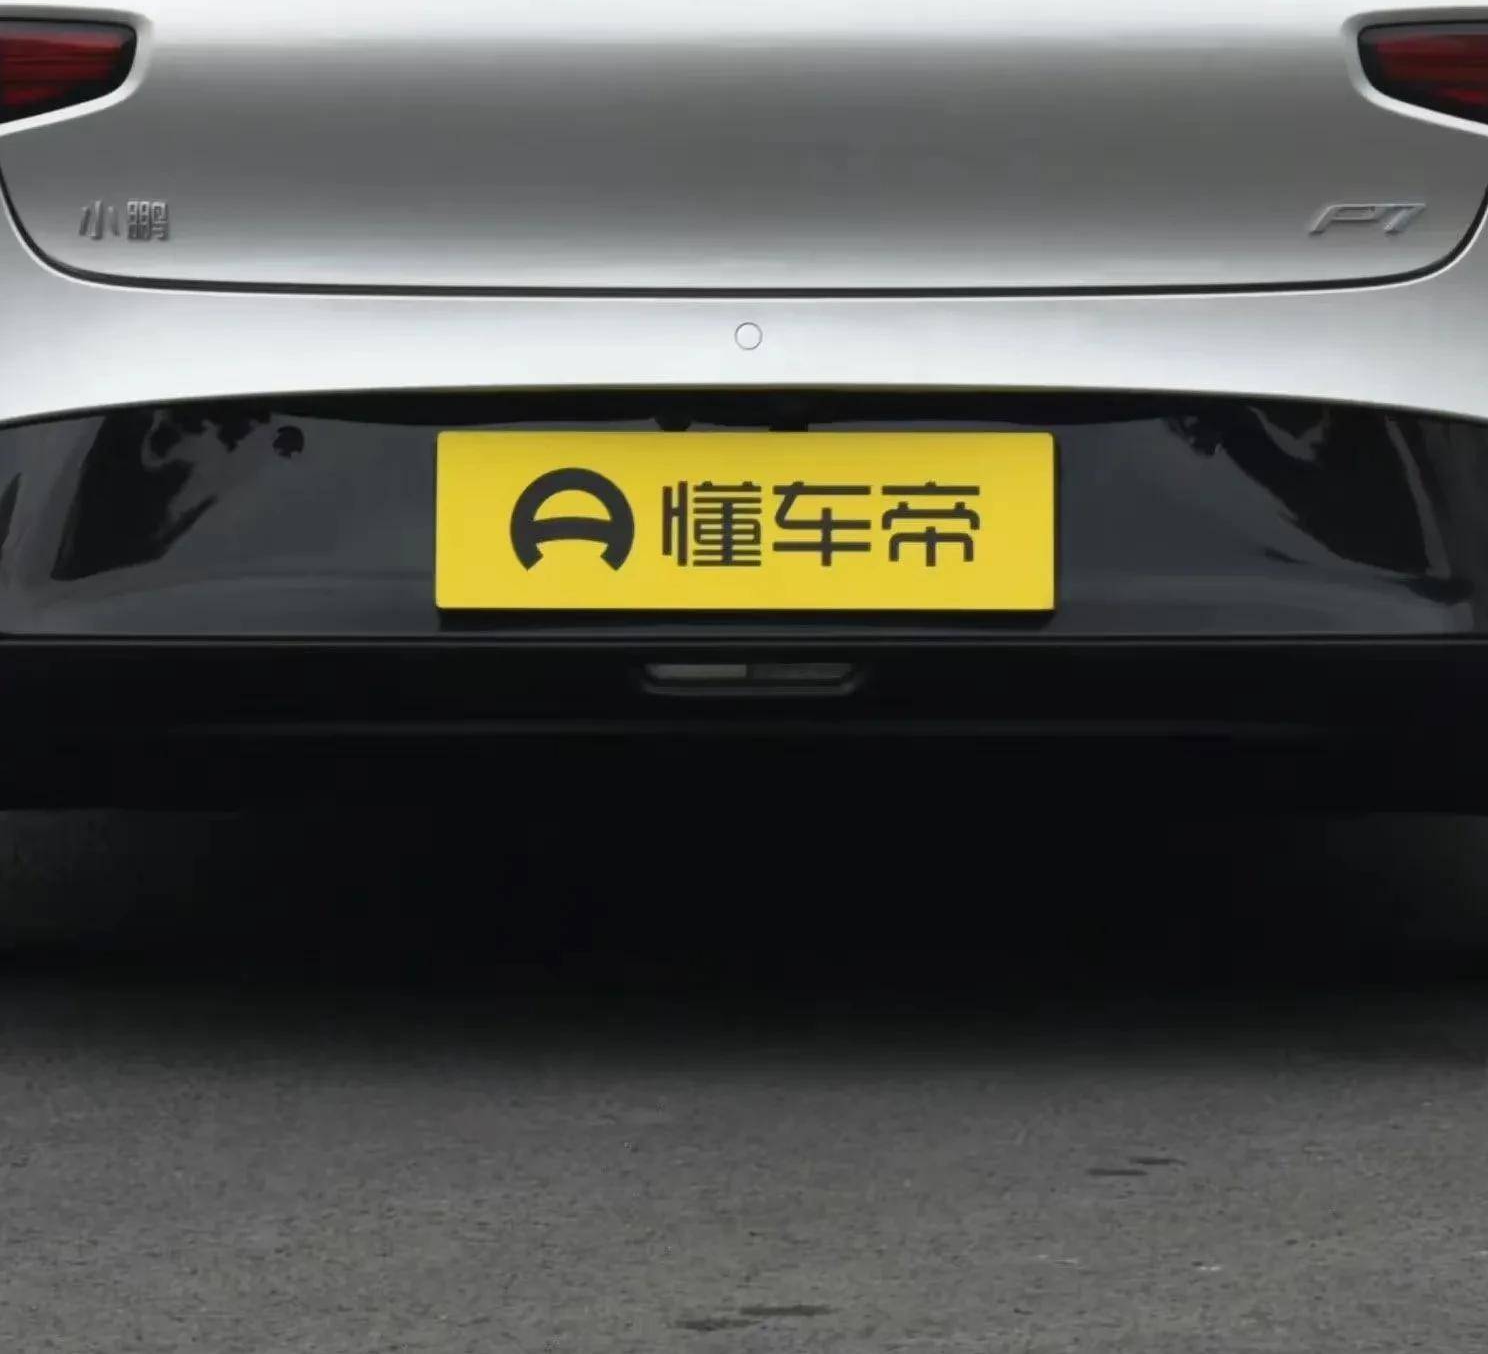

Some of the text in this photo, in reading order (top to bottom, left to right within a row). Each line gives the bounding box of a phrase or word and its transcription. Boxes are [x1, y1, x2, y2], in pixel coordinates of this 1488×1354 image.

[79, 200, 168, 241] 小鹏
[1309, 202, 1426, 237] P7
[661, 480, 981, 568] 懂车帝
